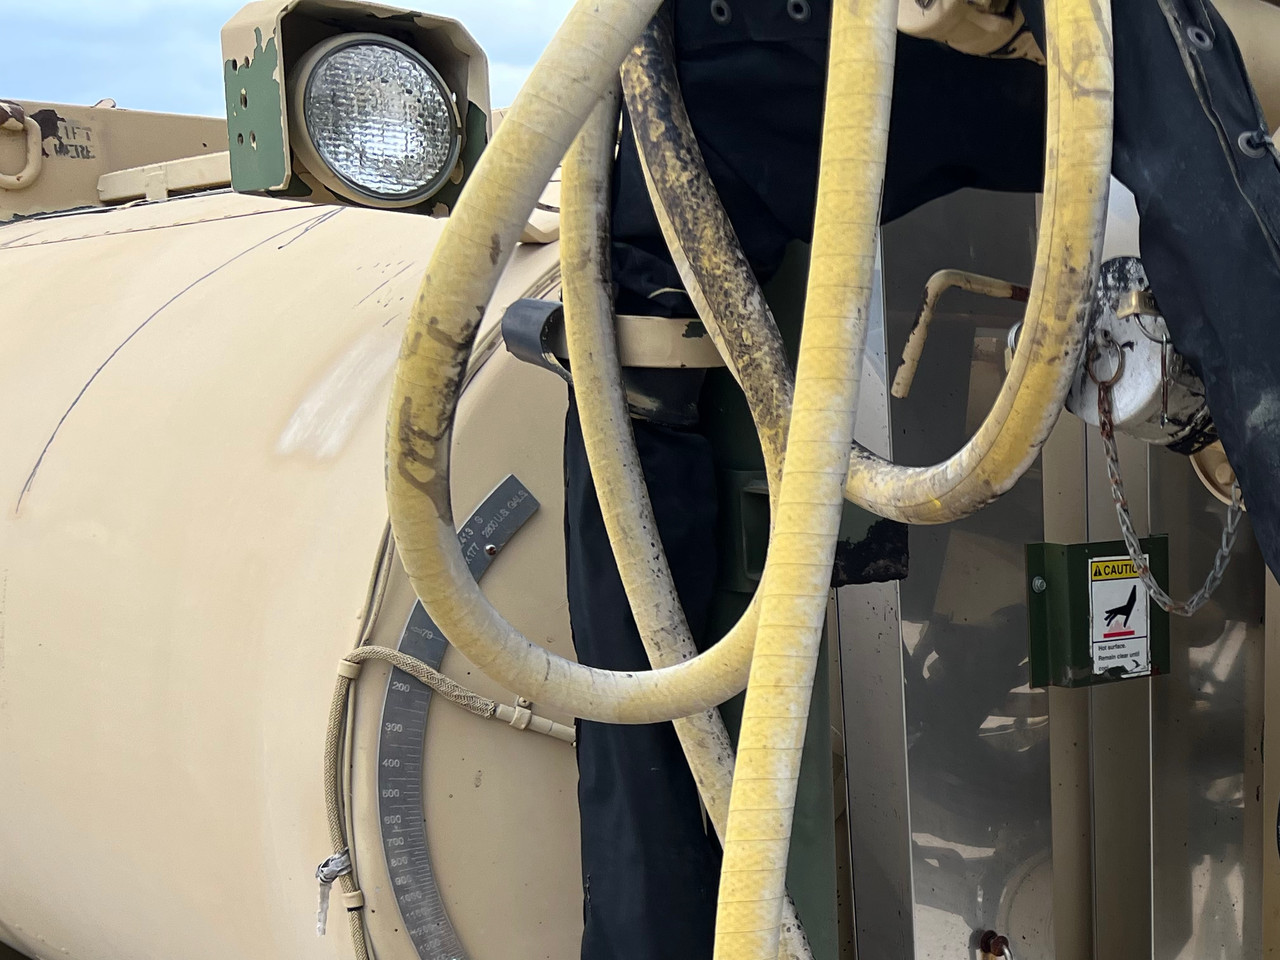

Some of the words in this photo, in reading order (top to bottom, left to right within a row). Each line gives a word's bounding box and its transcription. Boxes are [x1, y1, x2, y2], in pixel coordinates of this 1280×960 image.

[1103, 564, 1138, 576] CAUTIO
[391, 681, 410, 692] 200
[384, 722, 403, 733] 300
[382, 758, 400, 768] 400
[384, 814, 402, 825] 600
[386, 836, 405, 847] 700
[390, 856, 408, 867] 800
